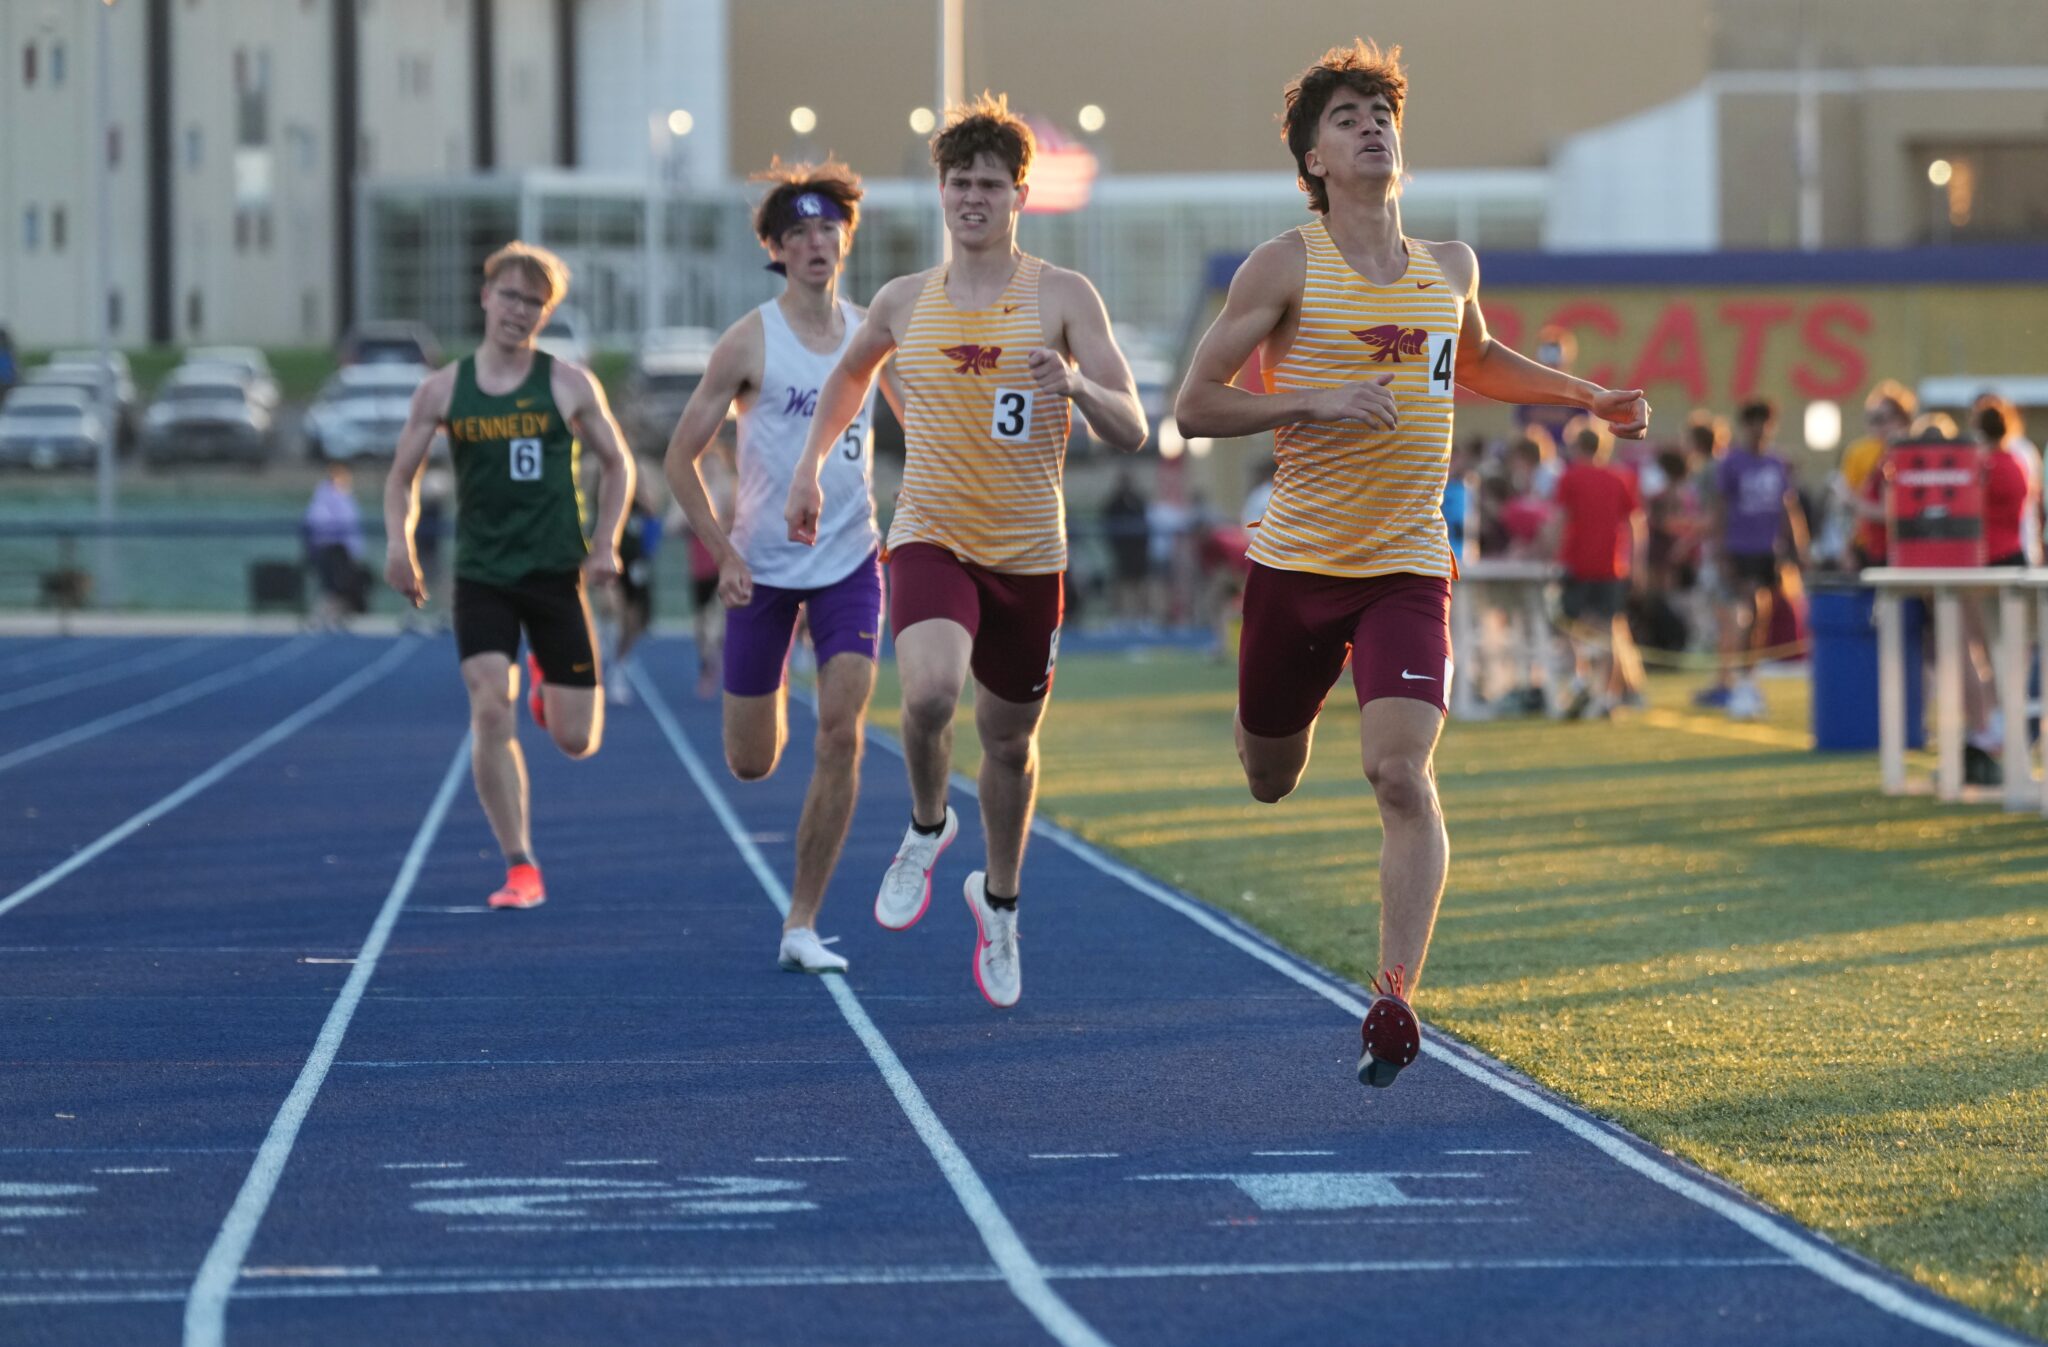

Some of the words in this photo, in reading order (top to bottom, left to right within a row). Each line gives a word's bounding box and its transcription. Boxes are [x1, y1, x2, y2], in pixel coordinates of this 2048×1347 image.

[1433, 338, 1452, 391] 4
[1454, 301, 1875, 404] CATS
[453, 412, 548, 441] KENNEDY
[997, 393, 1026, 436] 3
[516, 444, 535, 478] 6
[843, 423, 861, 462] 5
